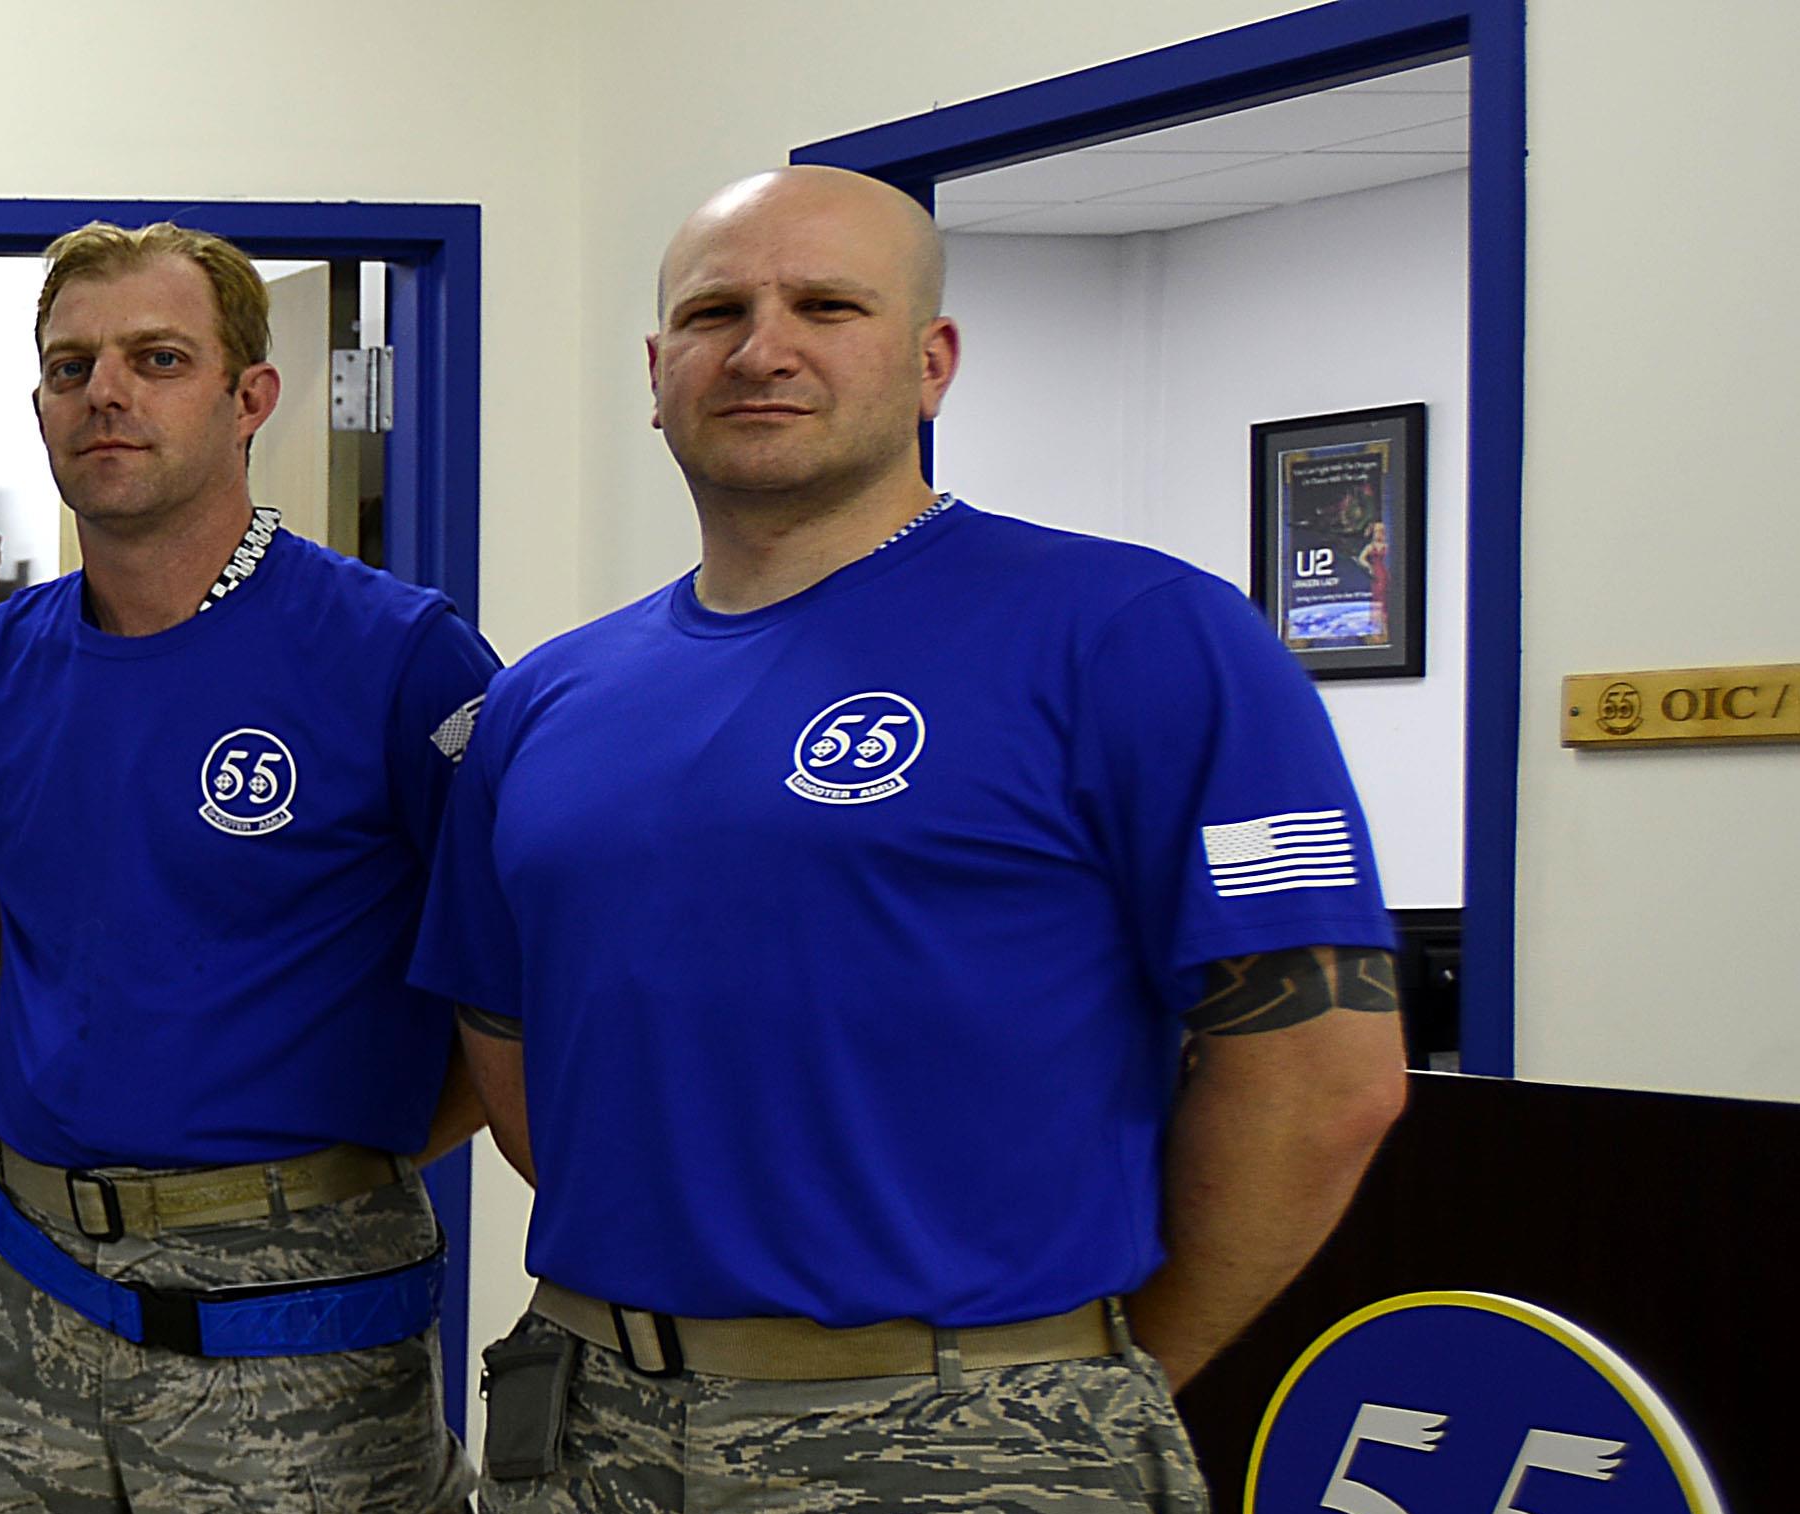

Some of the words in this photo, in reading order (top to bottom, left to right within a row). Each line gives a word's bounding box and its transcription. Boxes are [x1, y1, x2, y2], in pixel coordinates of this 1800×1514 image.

[1296, 549, 1333, 577] U2
[1661, 686, 1758, 722] OIC
[808, 714, 911, 769] 55
[214, 750, 283, 804] 55
